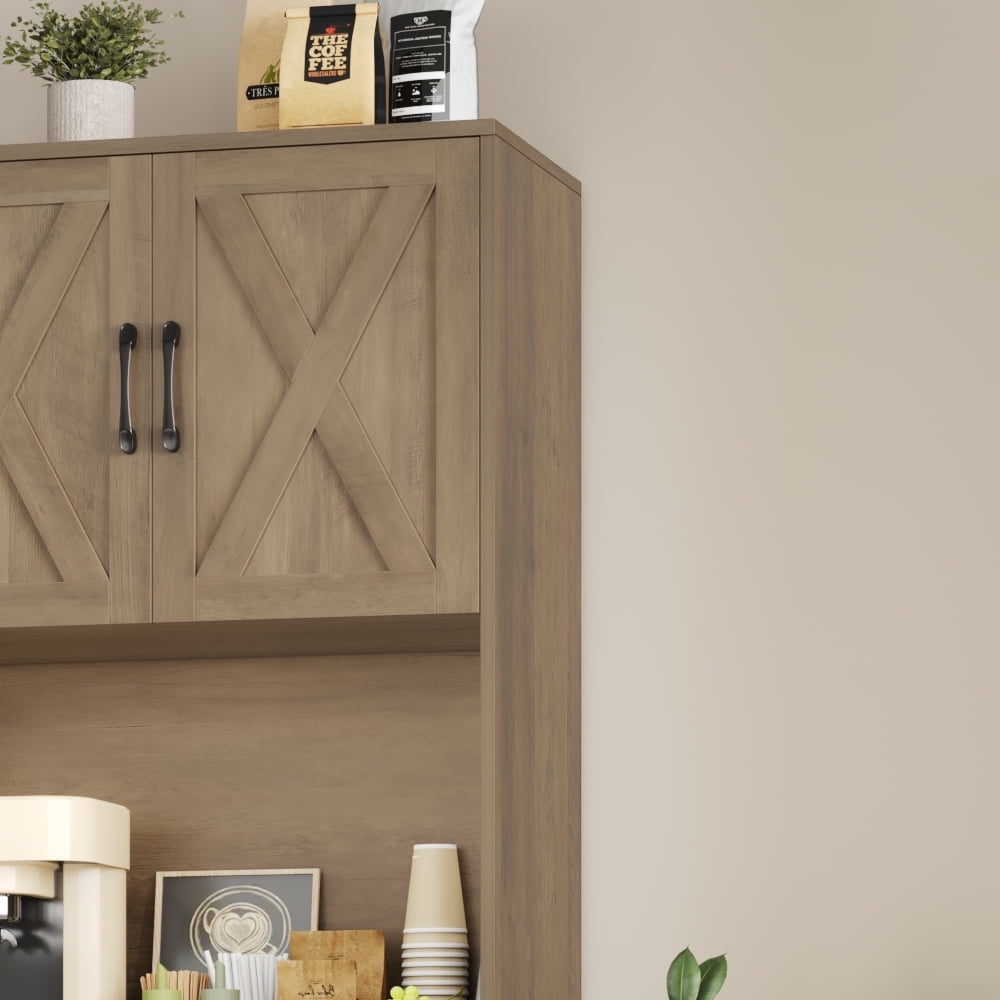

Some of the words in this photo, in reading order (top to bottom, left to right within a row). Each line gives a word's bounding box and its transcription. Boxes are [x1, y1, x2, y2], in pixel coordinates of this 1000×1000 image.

[309, 33, 349, 46] THE
[308, 45, 347, 58] COF
[307, 57, 347, 71] FEE
